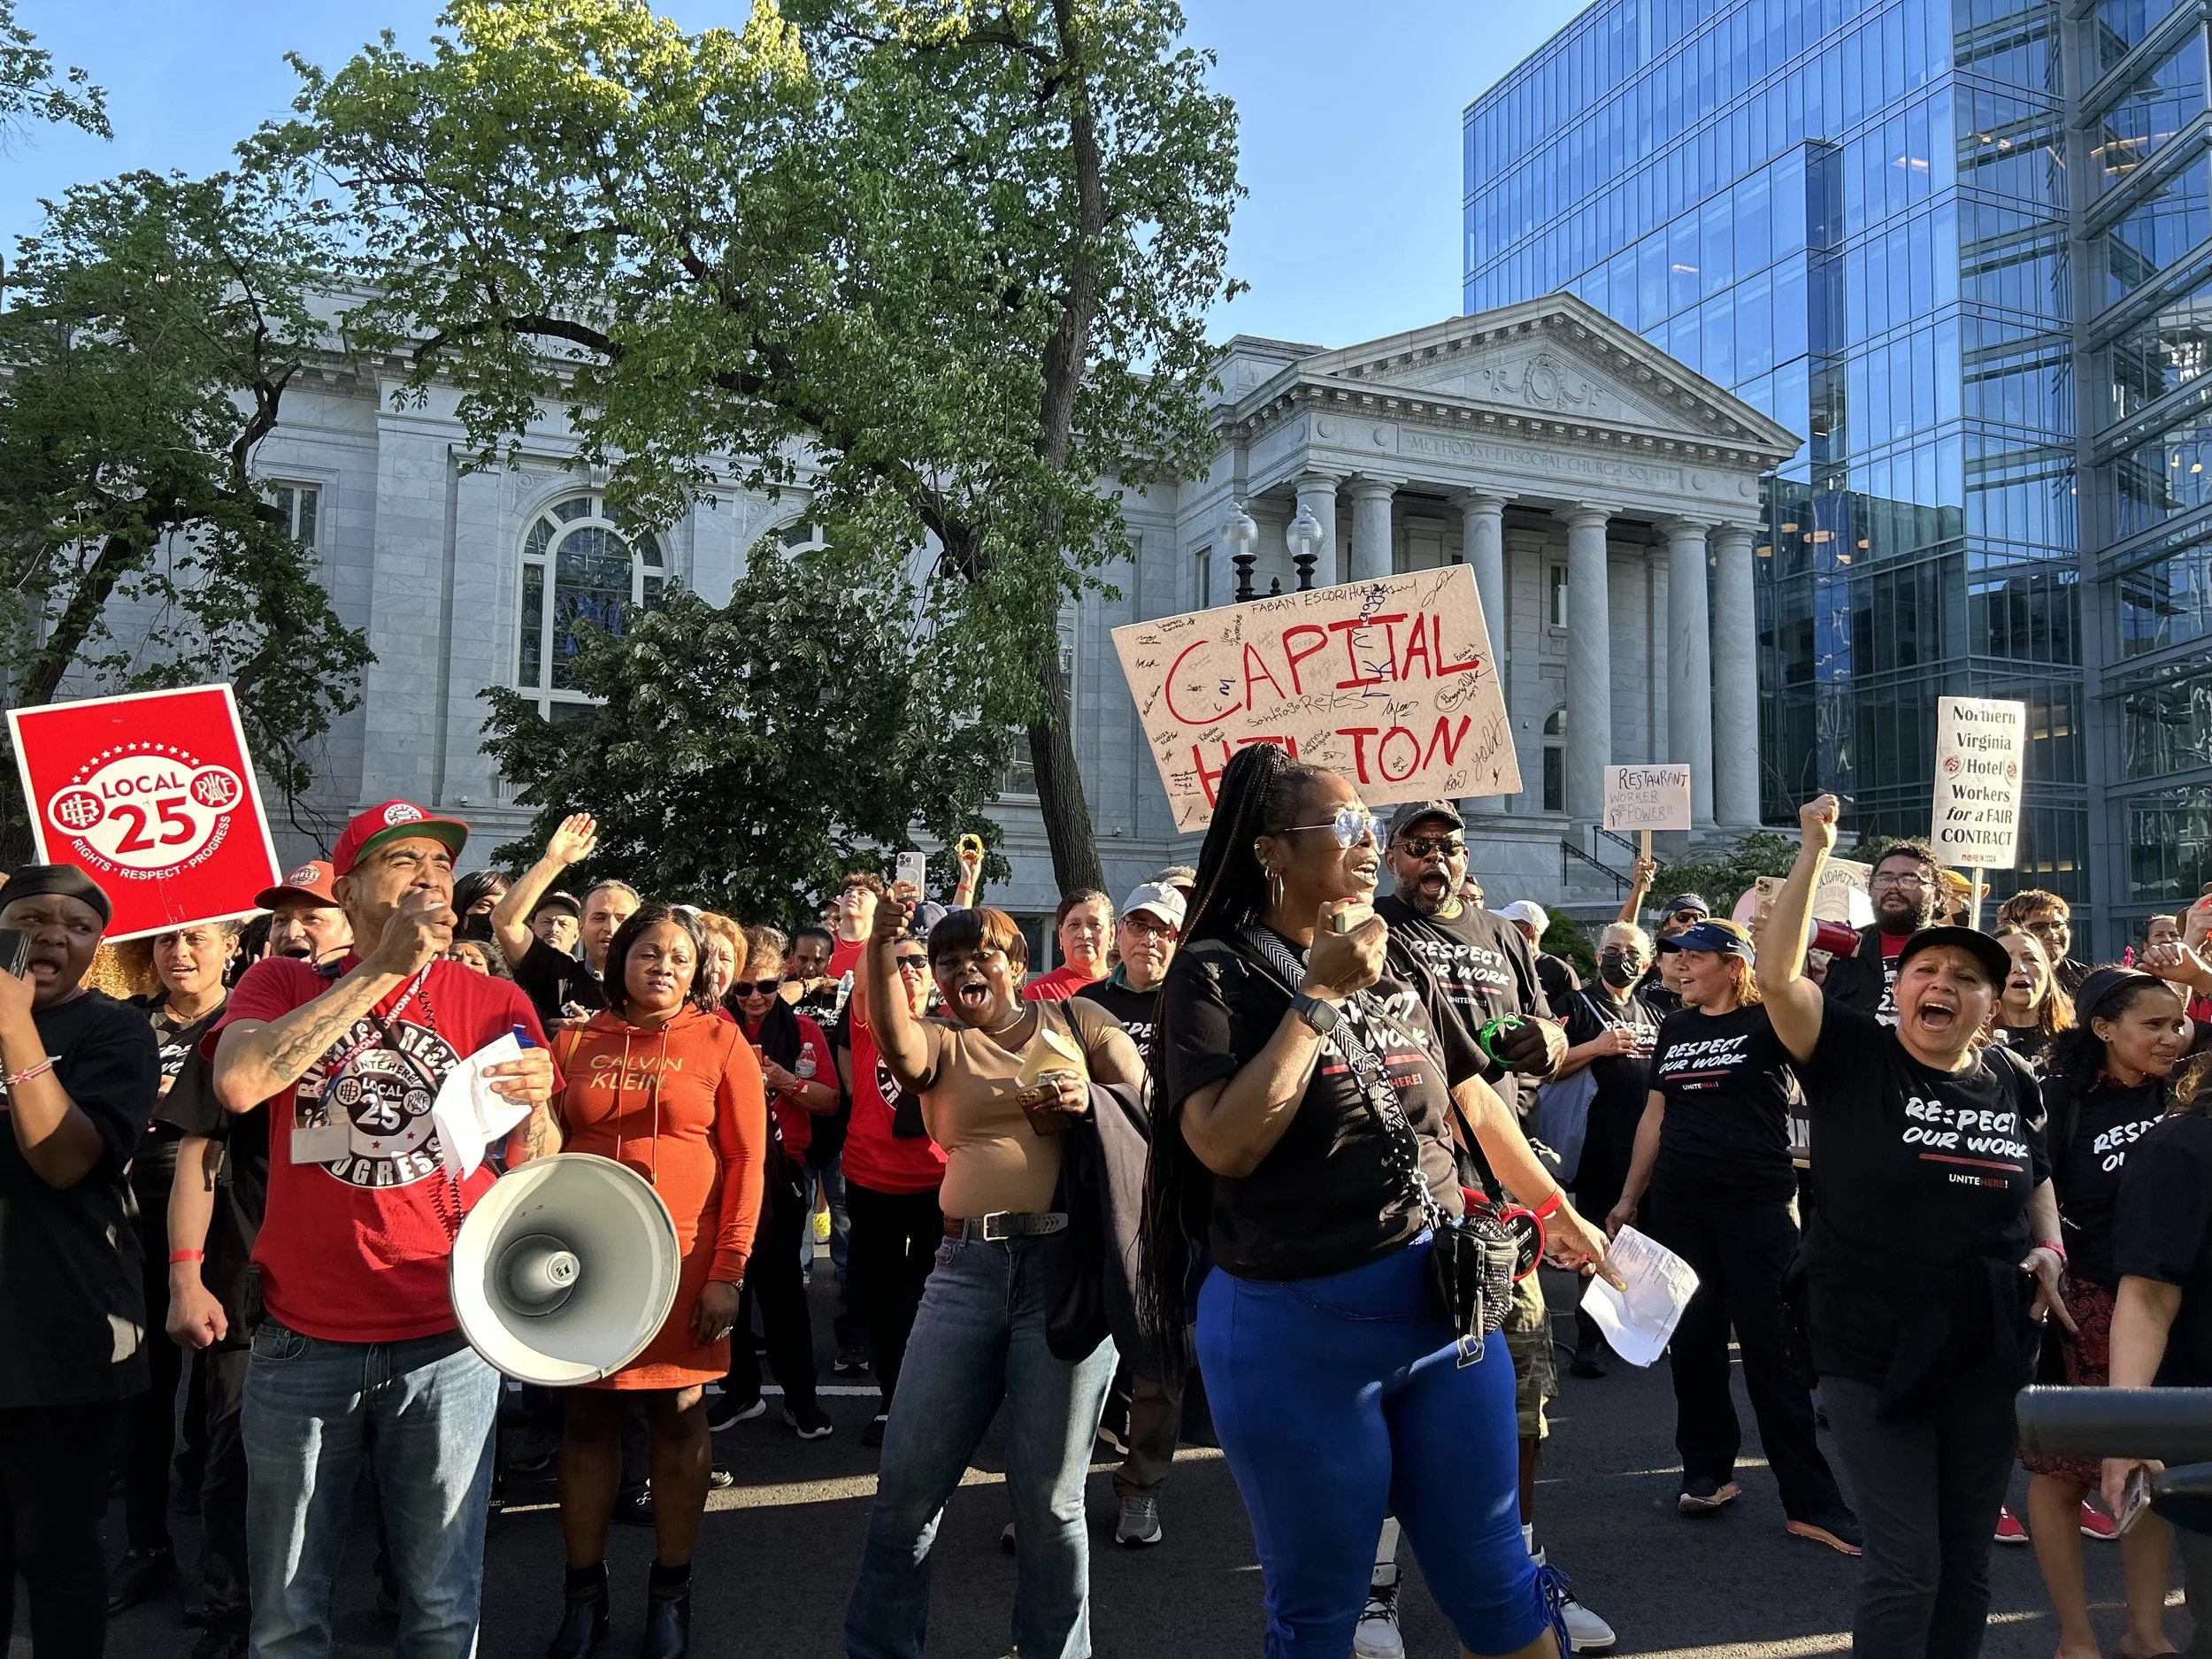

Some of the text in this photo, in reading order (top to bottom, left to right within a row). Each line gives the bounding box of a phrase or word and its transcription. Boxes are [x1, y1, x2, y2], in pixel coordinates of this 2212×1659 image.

[1567, 457, 1622, 476] CHURCH
[1627, 465, 1677, 482] SOUTH
[1251, 597, 1296, 615] FABIAN
[1164, 611, 1481, 725] CAPITAL
[1247, 703, 1300, 728] Santiago
[1953, 705, 2016, 725] Northern
[1956, 733, 2011, 751] Virginia
[1191, 714, 1473, 810] HTON
[1967, 758, 2003, 775] Hotel
[100, 771, 186, 800] LOCAL
[1618, 768, 1688, 790] RESTAURANT
[1609, 789, 1660, 803] WORKER
[1951, 784, 2010, 803] Workers
[107, 796, 196, 855] 25
[1946, 806, 2013, 824] for a FAIR
[71, 815, 233, 880] RIGHTS RESPECT PROGRESS
[1940, 828, 2013, 846] CONTRACT
[1456, 964, 1511, 987] WORK
[1663, 1034, 1749, 1061] RESPECT
[589, 1054, 683, 1071] CALVIN
[1658, 1054, 1748, 1075] OUR WORK
[362, 1077, 403, 1098] LOCAL
[589, 1071, 667, 1091] KLEIN
[356, 1093, 403, 1130] 25
[1901, 1126, 2029, 1159] OUR WORK
[1948, 1173, 2008, 1189] UNITEHERE!
